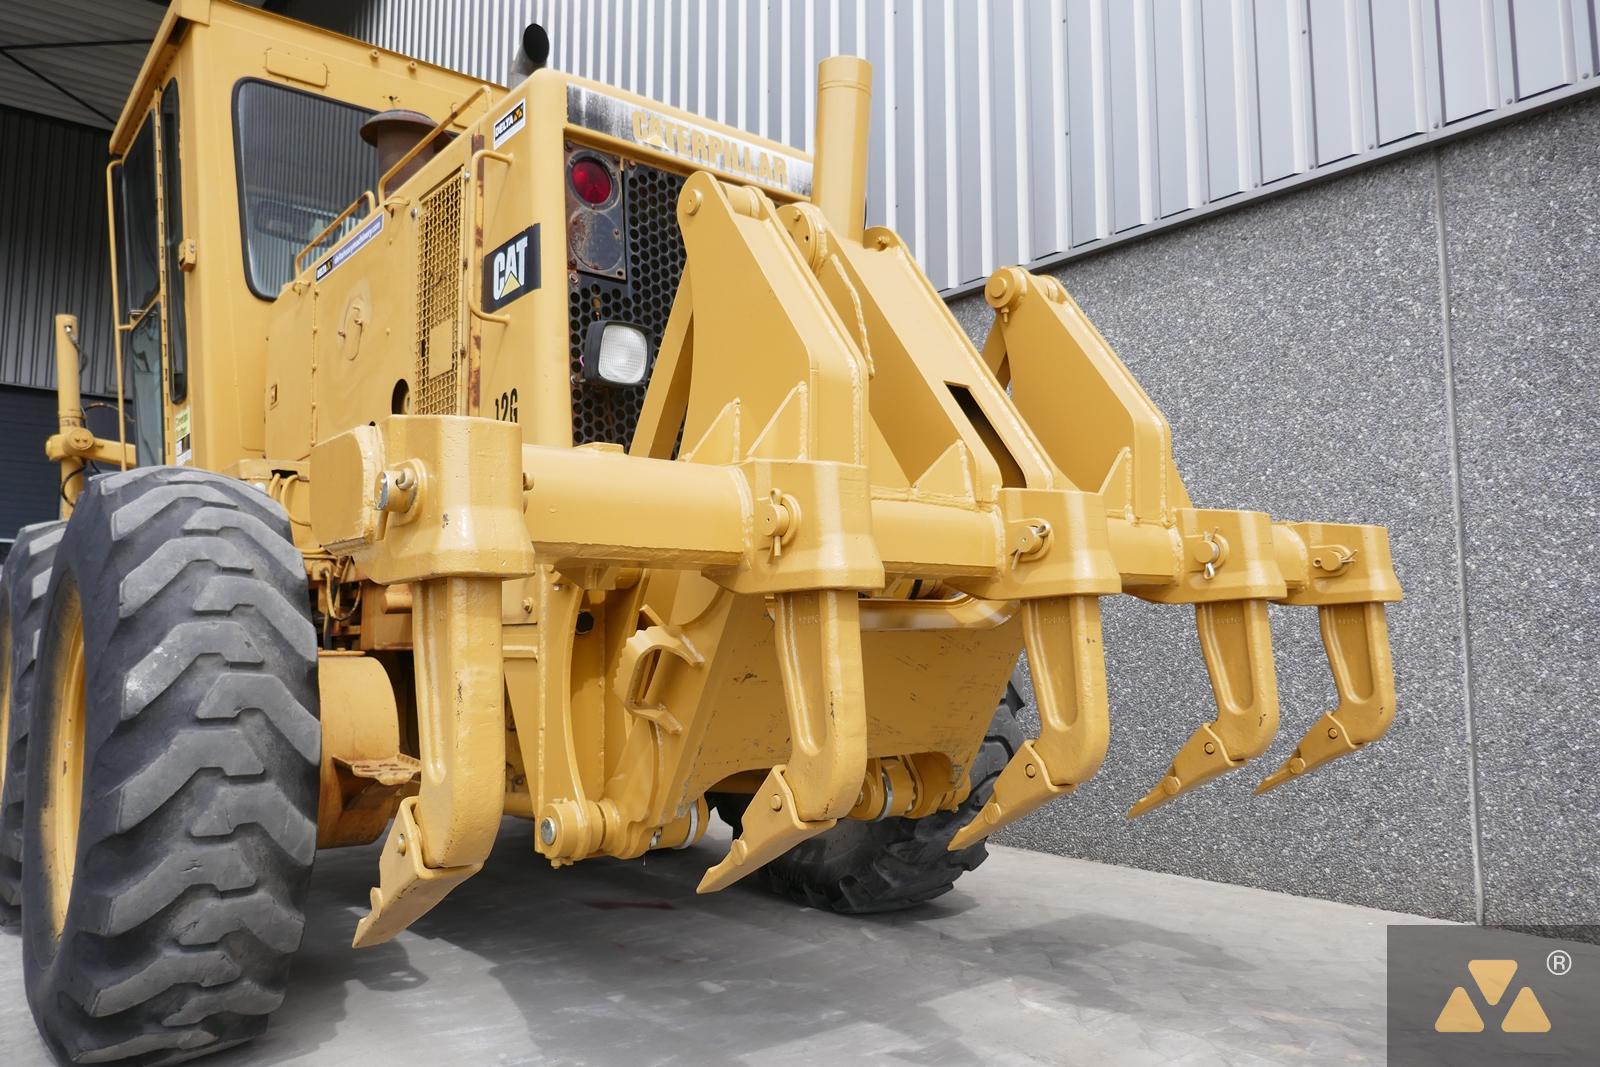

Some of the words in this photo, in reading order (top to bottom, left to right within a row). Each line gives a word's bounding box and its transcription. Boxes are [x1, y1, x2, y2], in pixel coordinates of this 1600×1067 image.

[632, 111, 788, 186] CATERPILLAR
[493, 236, 528, 300] CAT
[495, 387, 518, 423] 12G
